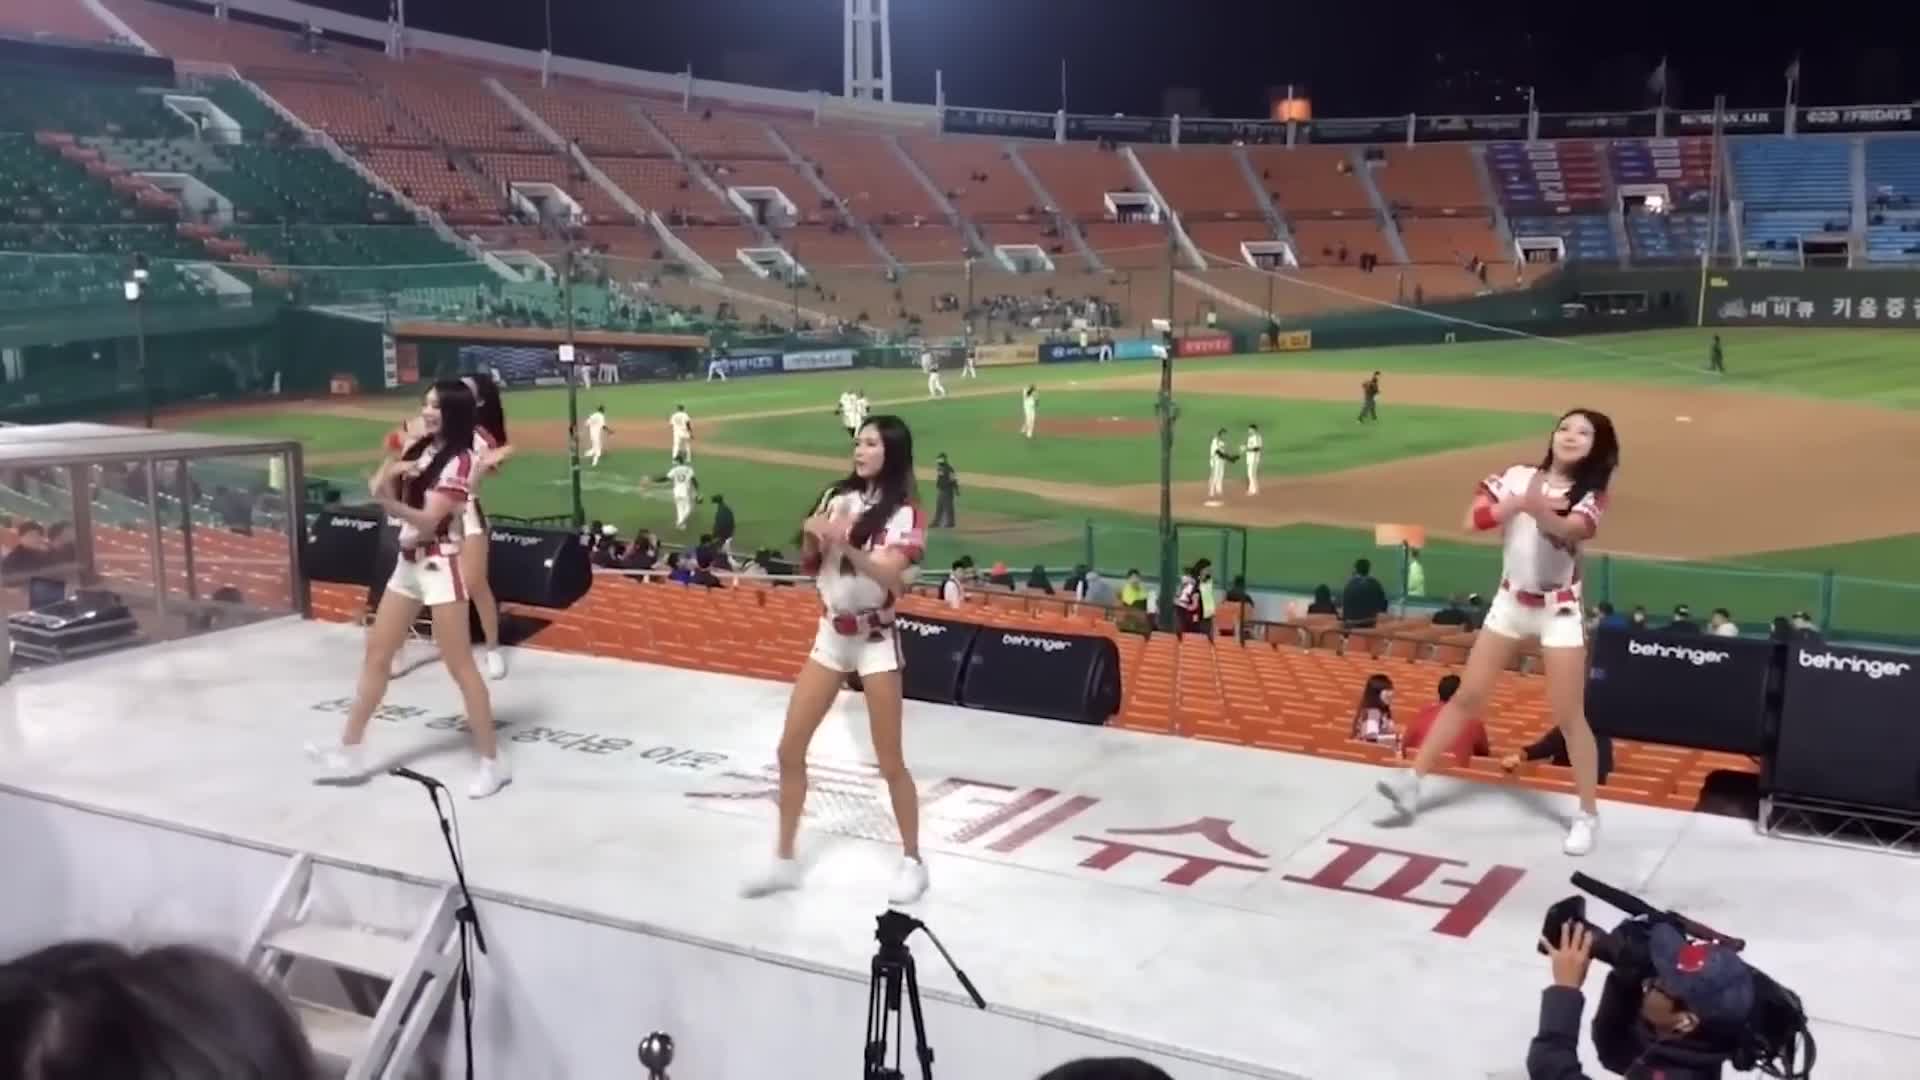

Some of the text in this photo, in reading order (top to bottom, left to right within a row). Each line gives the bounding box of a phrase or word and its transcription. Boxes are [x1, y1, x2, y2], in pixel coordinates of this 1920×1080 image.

[1751, 296, 1920, 319] 비비큐 키움증
[1001, 633, 1072, 652] behringer
[1628, 640, 1730, 666] behringer
[1798, 649, 1911, 679] behringer
[512, 726, 633, 755] 정다운
